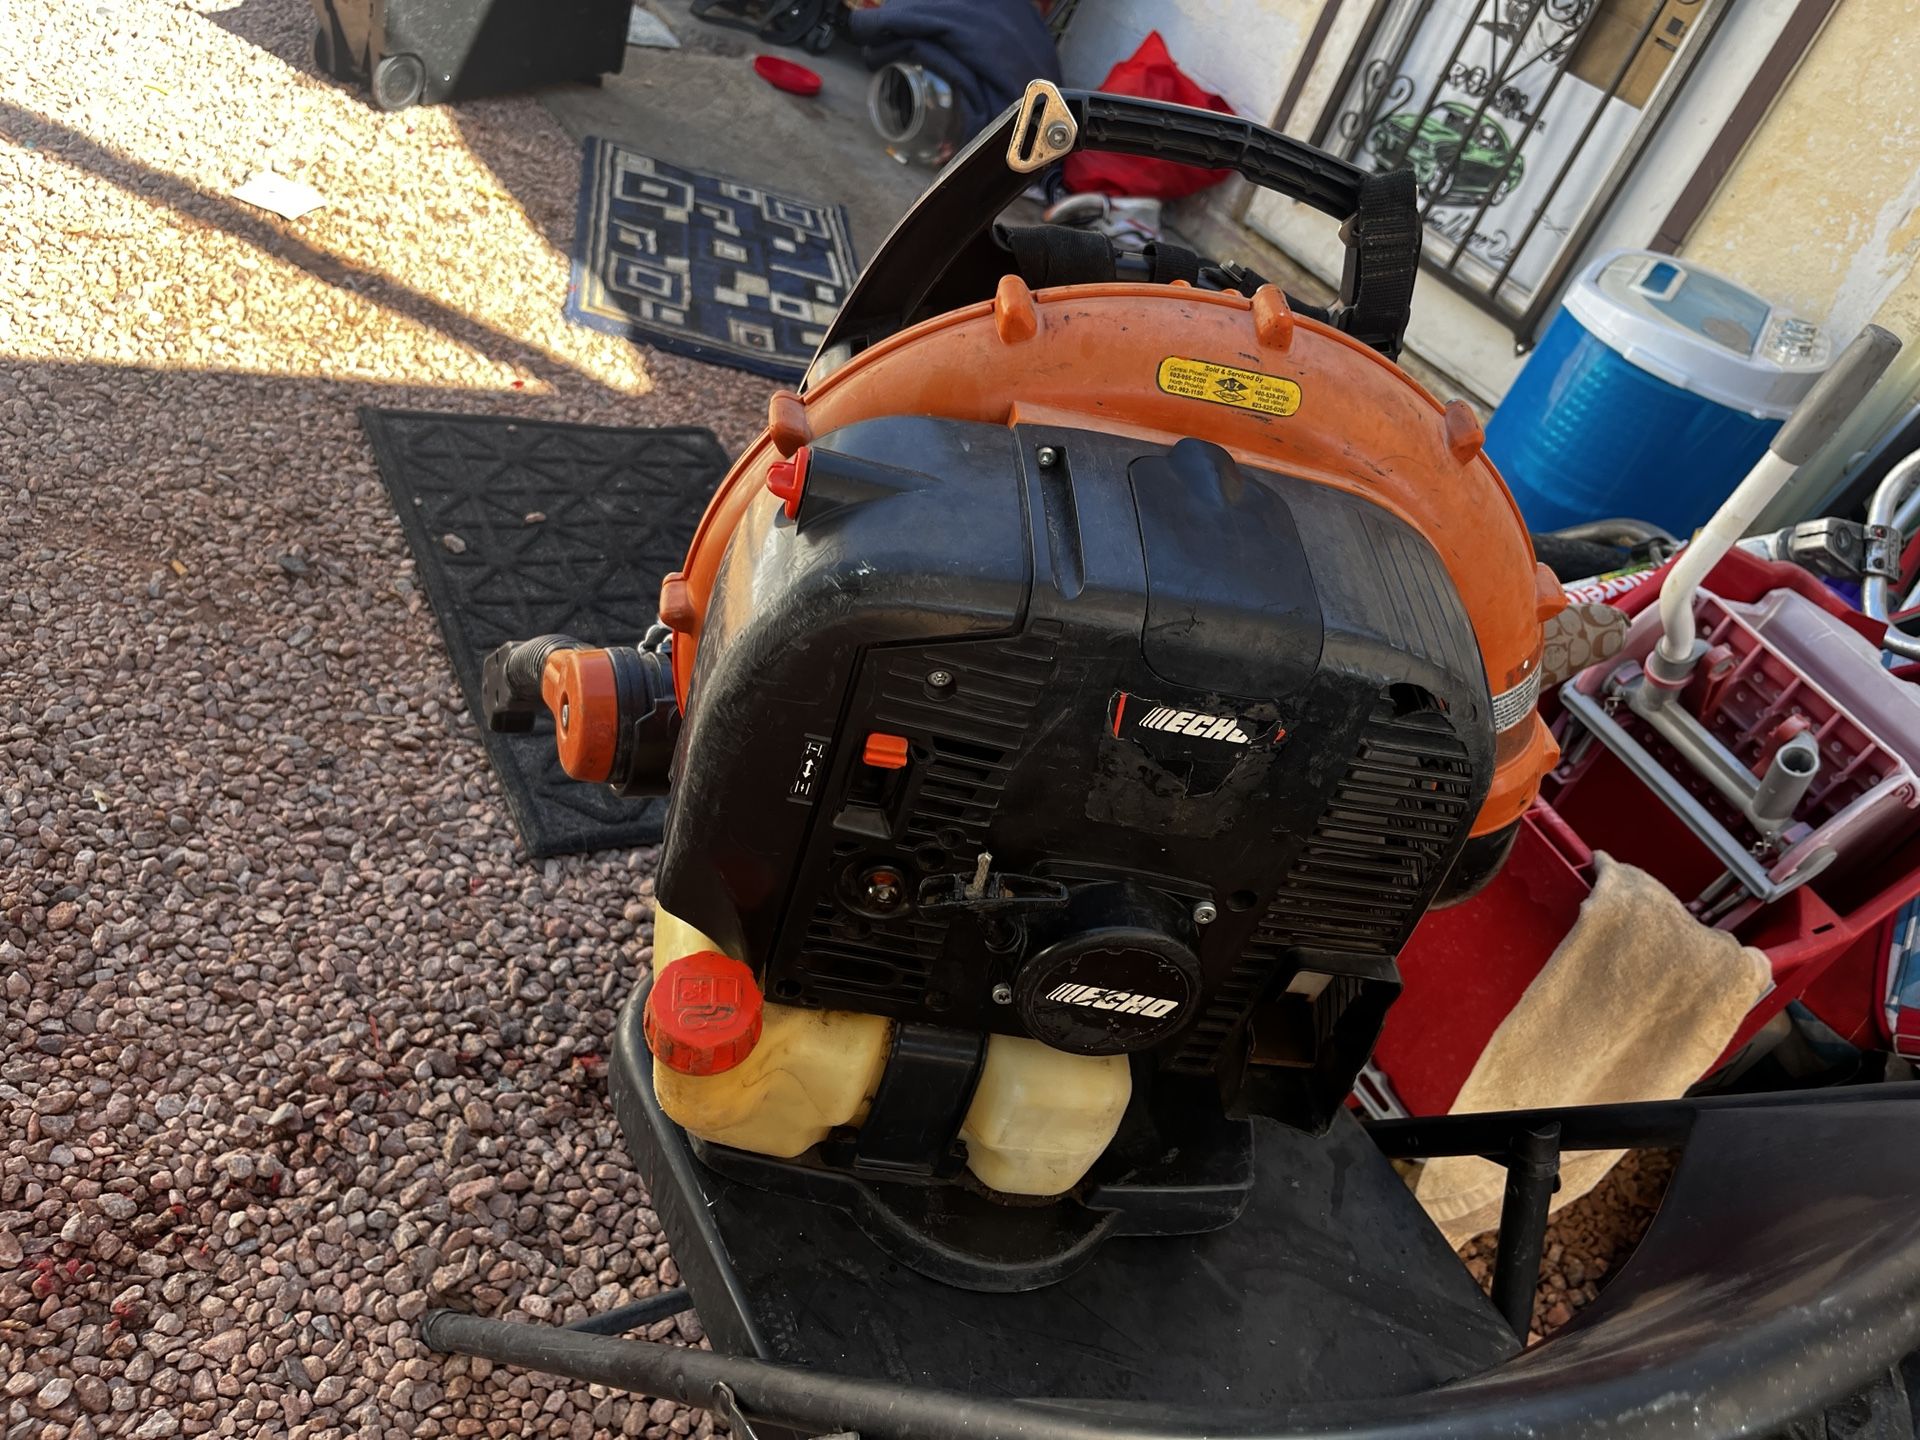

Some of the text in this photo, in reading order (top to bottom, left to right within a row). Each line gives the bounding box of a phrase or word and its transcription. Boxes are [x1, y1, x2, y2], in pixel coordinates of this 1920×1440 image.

[1204, 365, 1220, 374] Sold
[1227, 370, 1254, 382] Serviced
[1255, 375, 1264, 384] by
[1075, 986, 1180, 1019] ECHO
